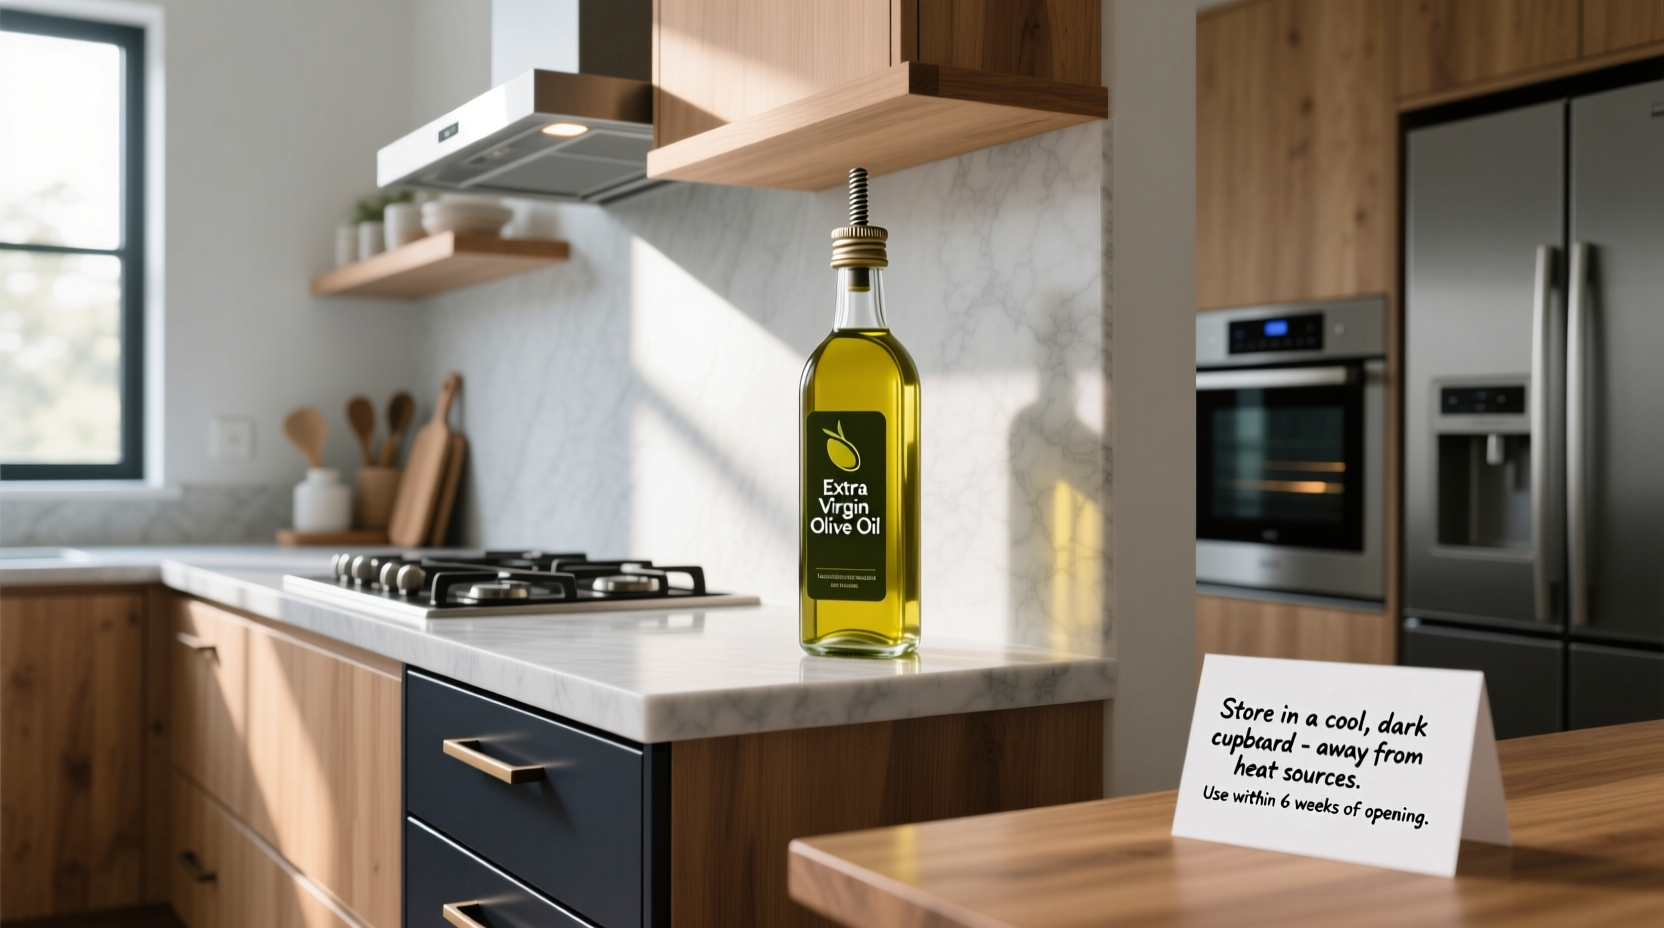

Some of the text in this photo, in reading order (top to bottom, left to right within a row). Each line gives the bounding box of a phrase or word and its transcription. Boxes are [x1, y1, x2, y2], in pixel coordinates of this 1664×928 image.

[824, 479, 868, 496] Extra
[818, 497, 869, 520] Virgin
[810, 516, 881, 535] Olive Oil
[1220, 697, 1428, 737] Store in a cool, dark
[1316, 742, 1370, 768] away
[1373, 740, 1424, 766] from
[1233, 753, 1361, 790] heat sources.
[1203, 785, 1430, 830] Use within 6 weeks of opening.
